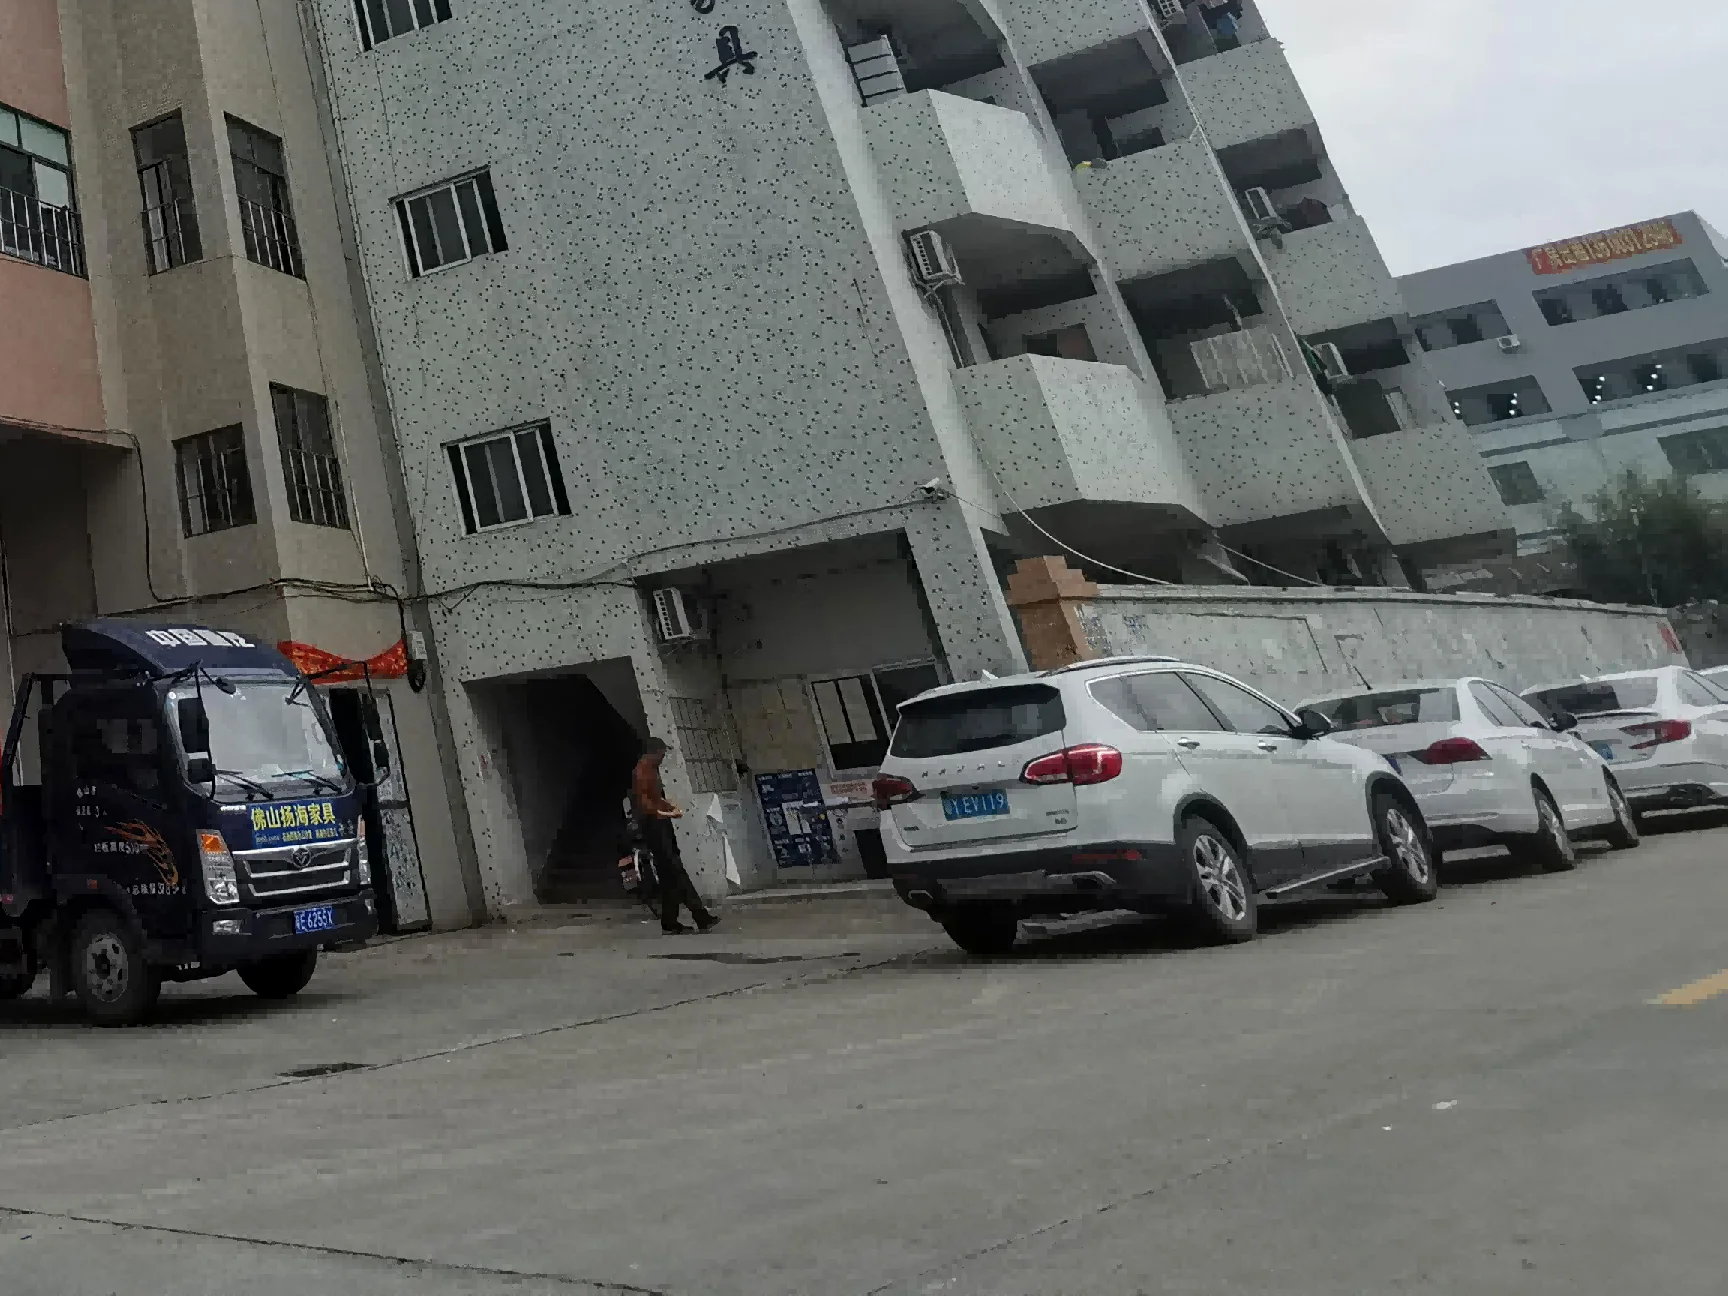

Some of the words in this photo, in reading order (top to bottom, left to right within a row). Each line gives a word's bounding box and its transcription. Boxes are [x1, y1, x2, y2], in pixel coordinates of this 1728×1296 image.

[251, 802, 336, 831] 佛山扬海家具
